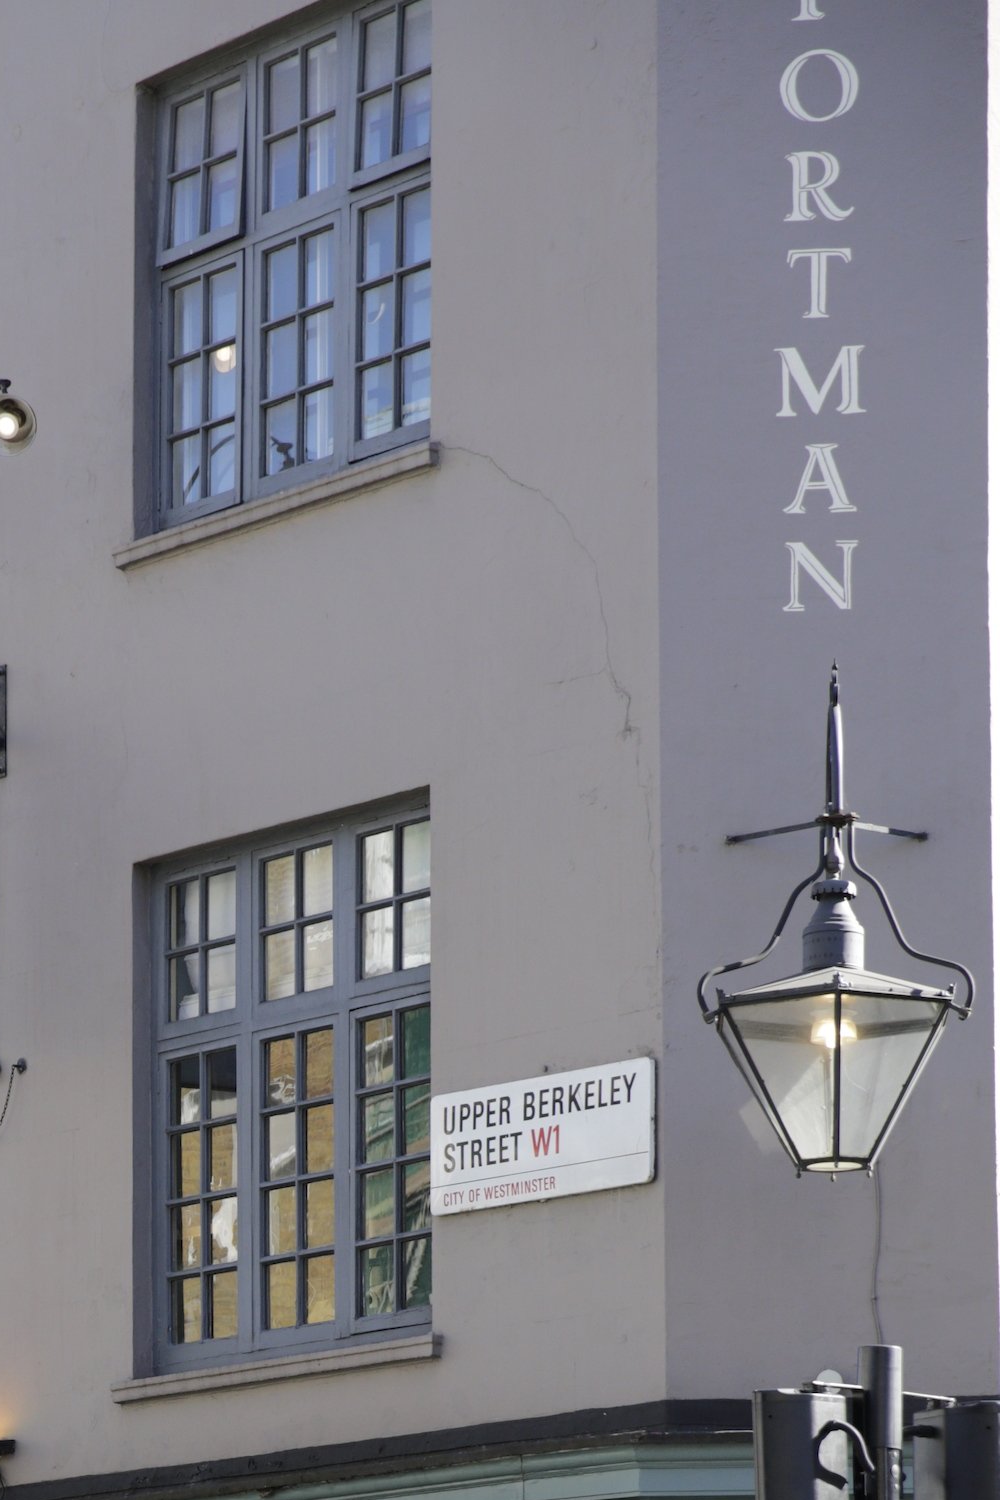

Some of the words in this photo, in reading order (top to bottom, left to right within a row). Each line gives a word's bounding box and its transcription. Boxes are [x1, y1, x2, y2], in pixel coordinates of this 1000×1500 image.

[774, 0, 866, 612] ORTMAN
[444, 1096, 511, 1135] UPPER
[523, 1073, 637, 1121] BERKELEY
[444, 1132, 522, 1173] STREET
[531, 1125, 561, 1158] W1
[444, 1188, 464, 1207] CITY
[469, 1186, 480, 1202] OF
[484, 1176, 556, 1200] WESTMINSTER
